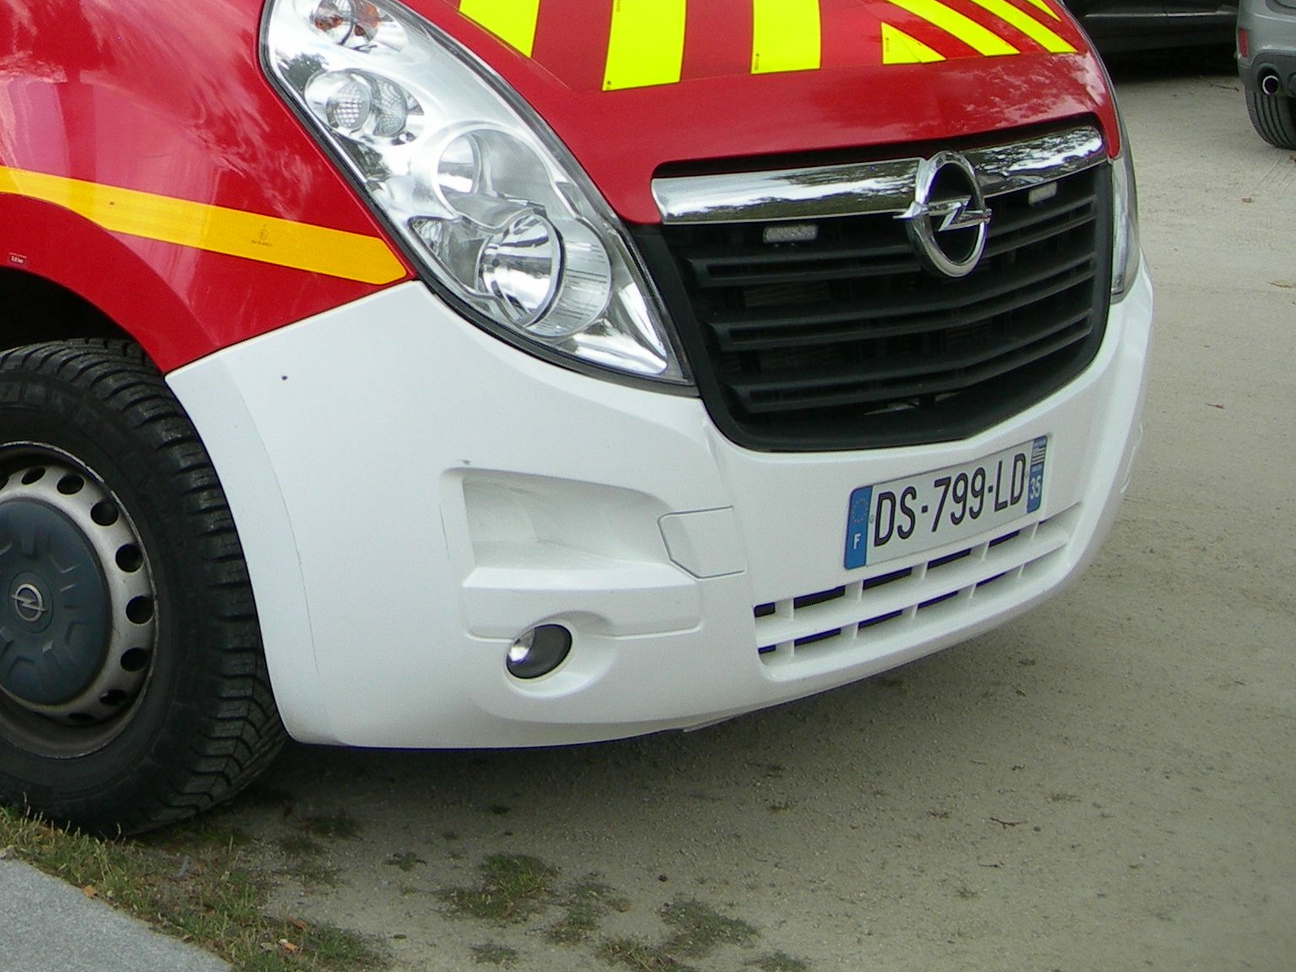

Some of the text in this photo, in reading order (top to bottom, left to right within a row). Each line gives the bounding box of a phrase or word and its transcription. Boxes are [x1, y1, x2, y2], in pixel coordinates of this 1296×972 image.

[1029, 474, 1042, 500] 35
[873, 453, 1027, 548] DS-799-LD
[853, 532, 862, 549] F
